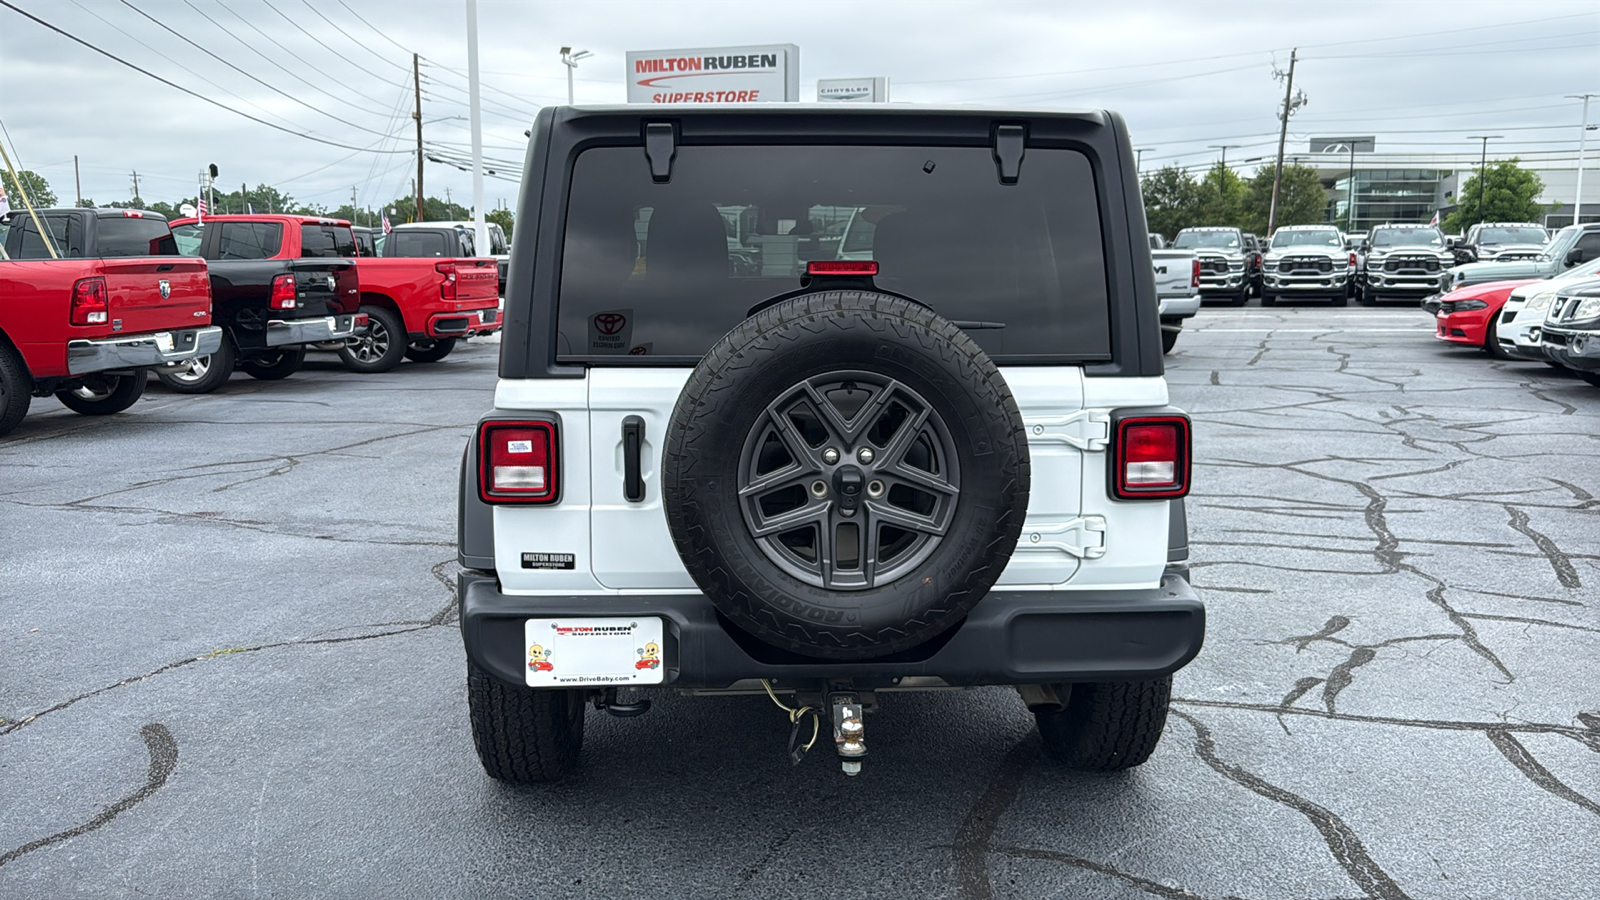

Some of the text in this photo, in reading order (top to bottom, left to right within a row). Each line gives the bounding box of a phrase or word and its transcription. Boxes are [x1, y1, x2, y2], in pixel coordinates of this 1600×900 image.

[635, 54, 777, 73] MILTON RUBEN
[652, 90, 760, 103] SUPERSTORE
[523, 553, 573, 562] MILTON RUBEN
[738, 564, 844, 624] ROADIAN
[560, 675, 630, 683] www.DriveBaby.com
